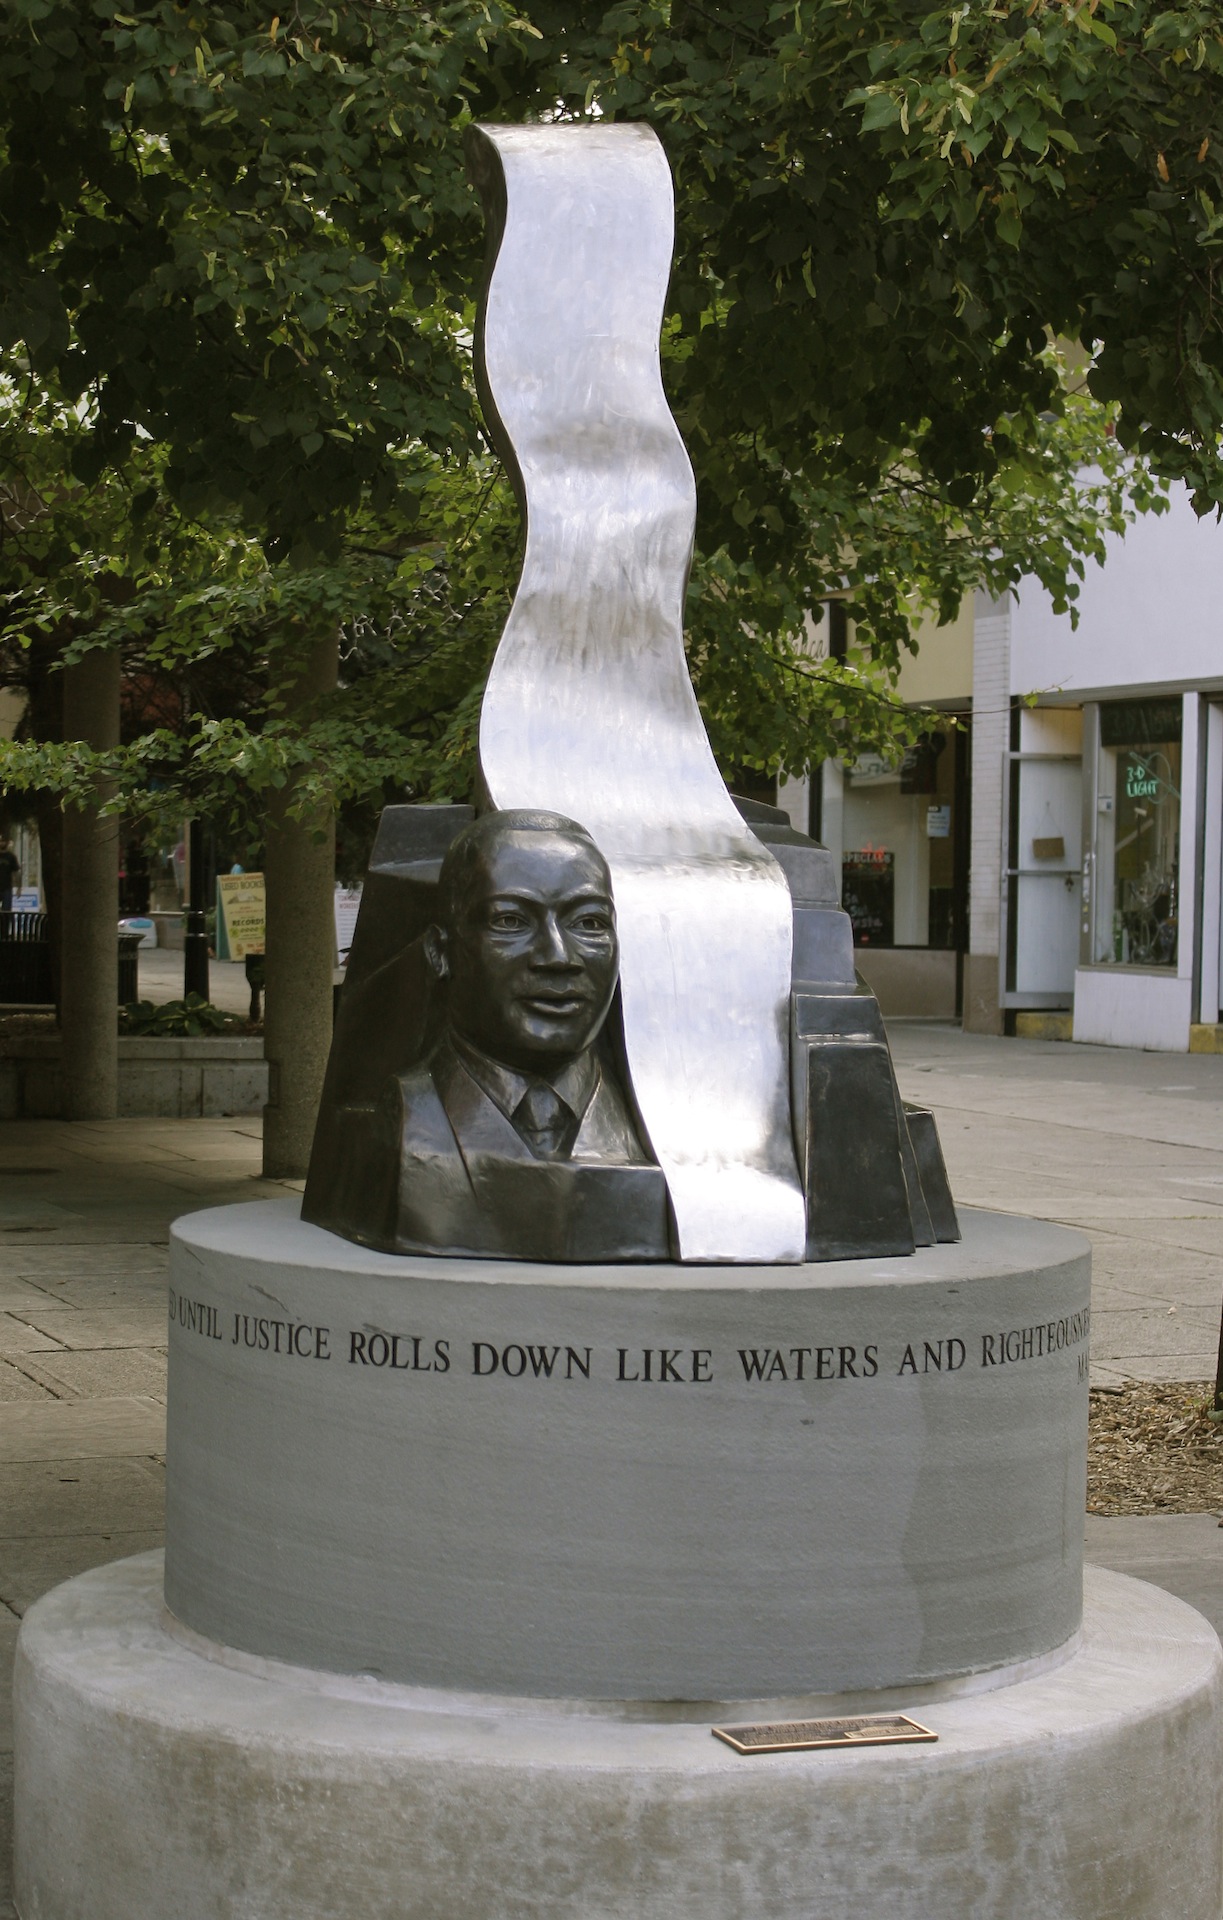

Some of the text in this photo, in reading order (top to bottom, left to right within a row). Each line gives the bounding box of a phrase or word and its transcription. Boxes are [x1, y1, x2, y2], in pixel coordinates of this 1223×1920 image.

[1127, 780, 1159, 797] LIGHT
[232, 918, 264, 926] RECORDS
[179, 1295, 223, 1340] UNTIL
[232, 1313, 332, 1360] JUSTICE
[348, 1331, 450, 1373] ROLLS
[471, 1342, 593, 1379] DOWN
[616, 1348, 713, 1382] LIKE
[737, 1345, 879, 1382] WATERS
[898, 1337, 967, 1376] AND
